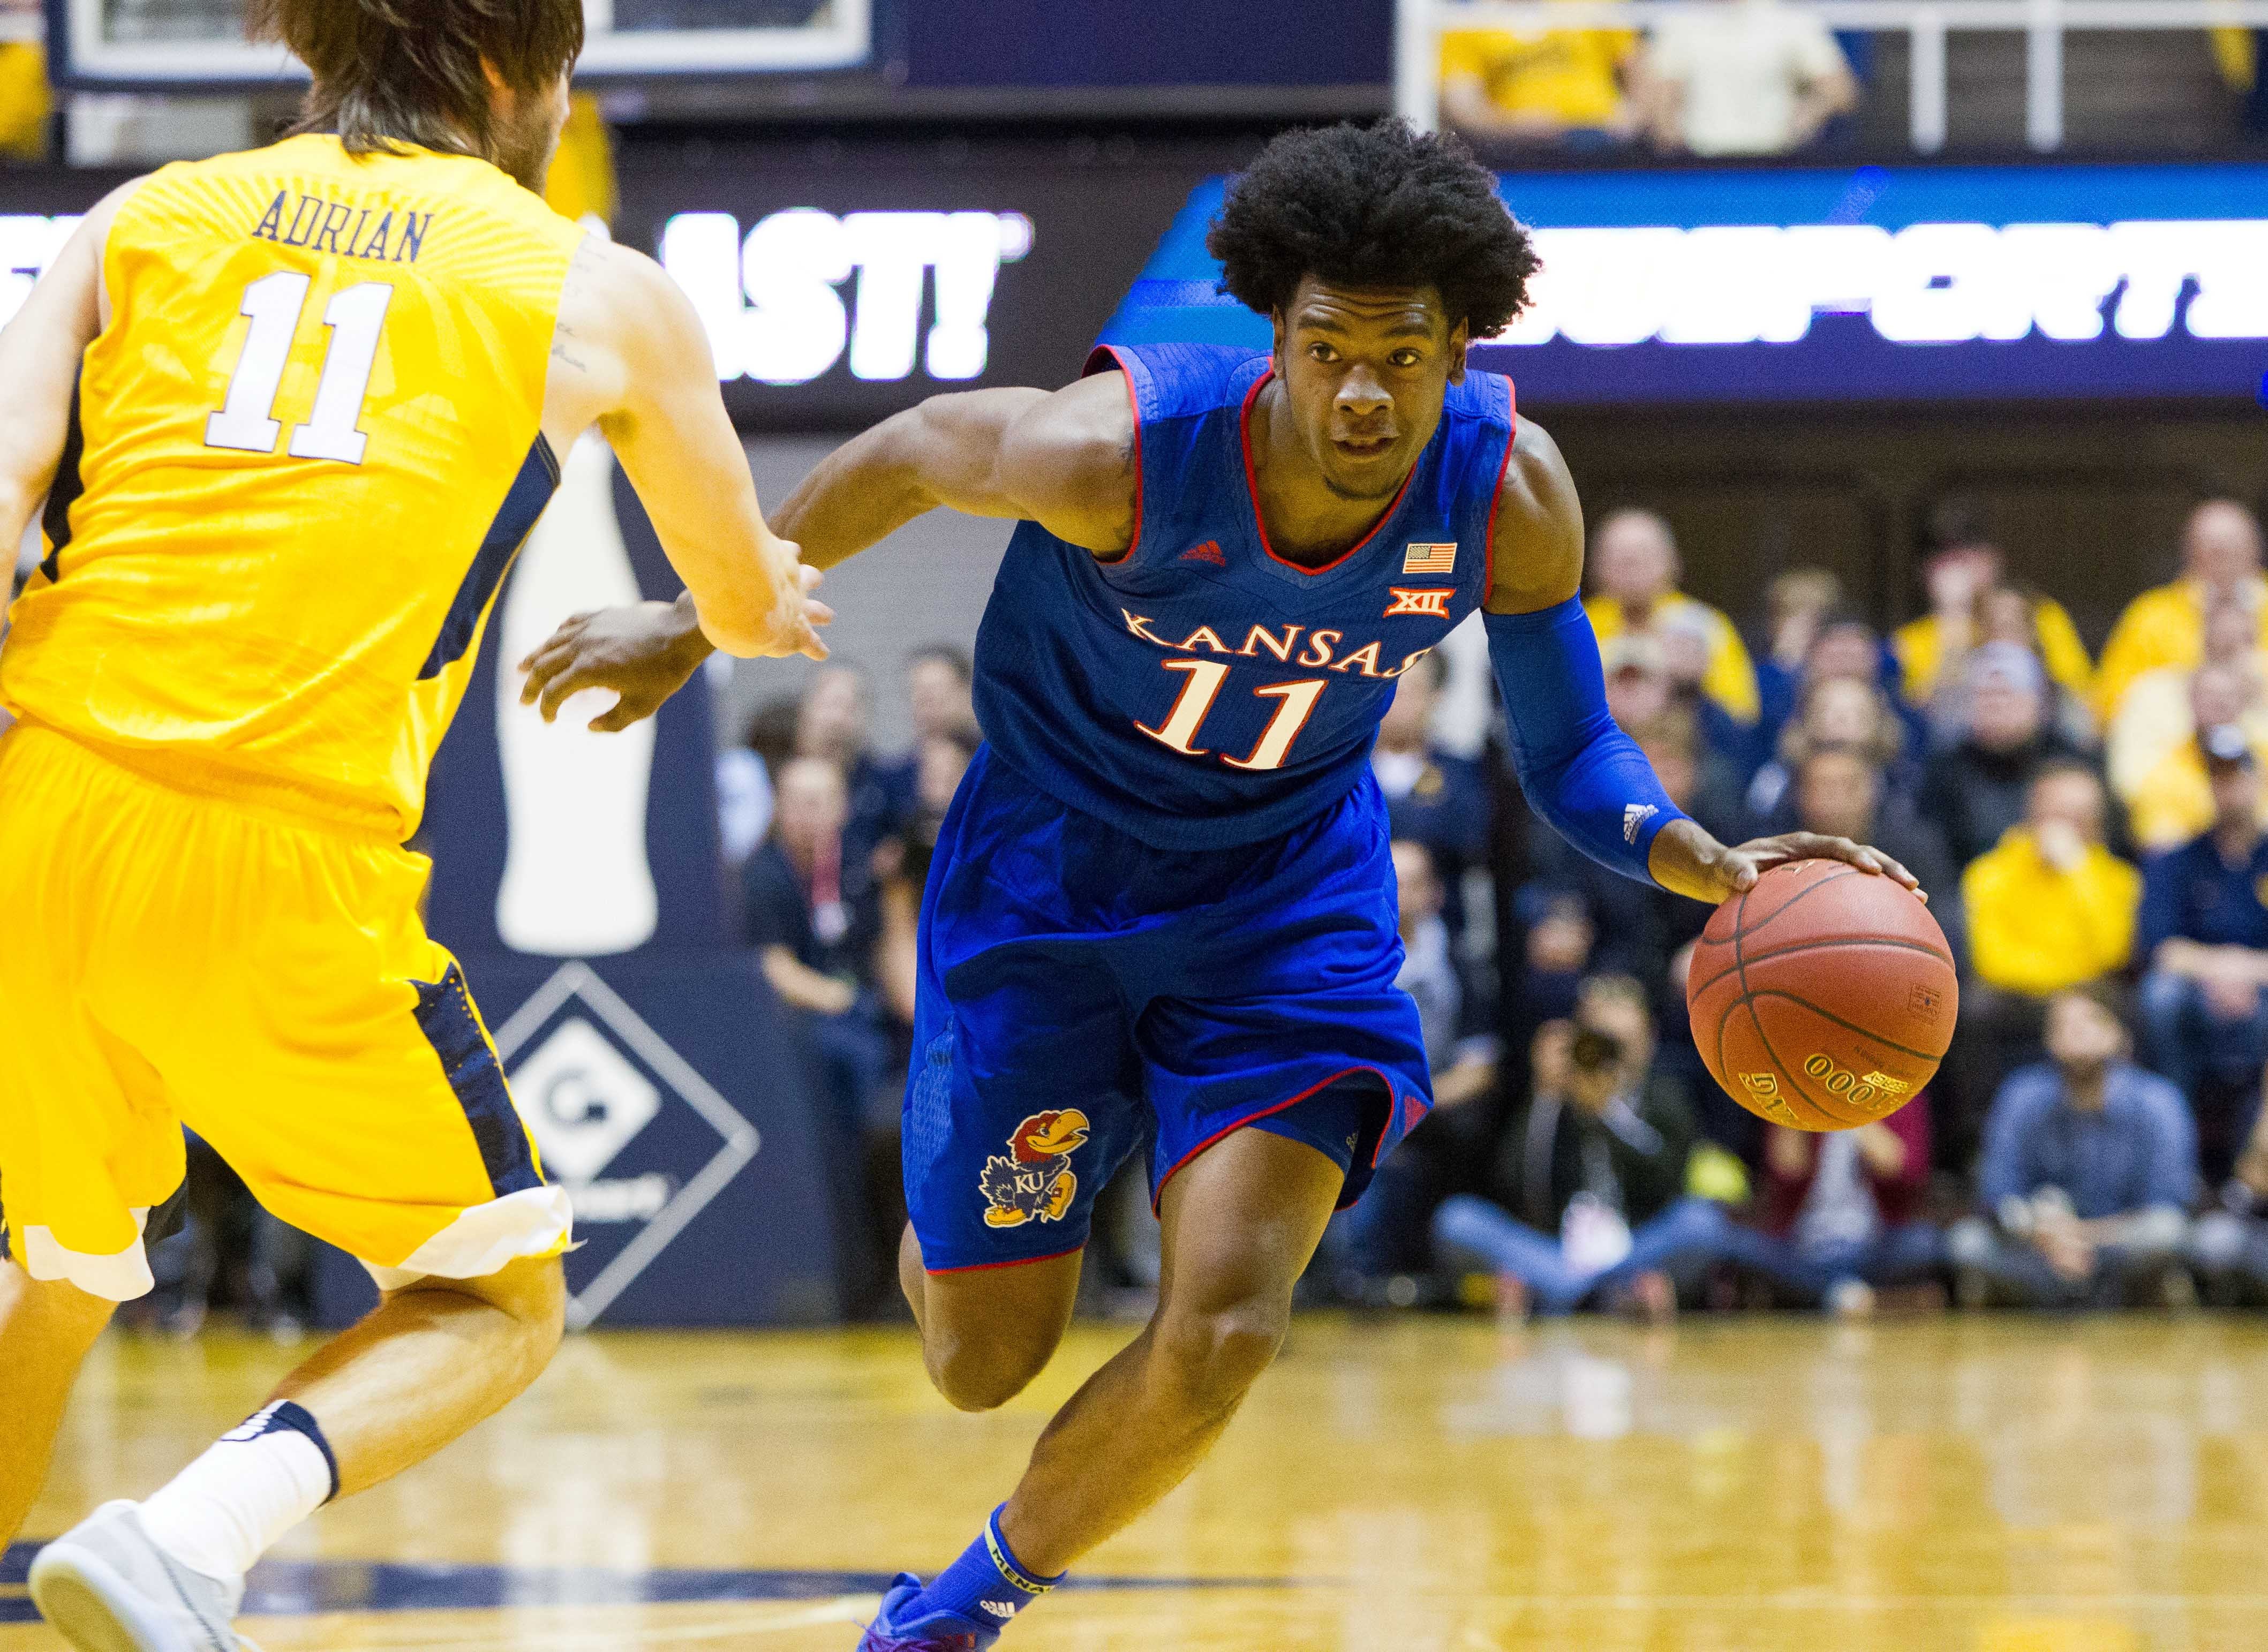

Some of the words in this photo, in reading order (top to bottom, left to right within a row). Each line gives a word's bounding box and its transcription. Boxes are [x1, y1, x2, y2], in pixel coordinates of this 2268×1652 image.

[252, 189, 433, 264] ADRIAN
[204, 270, 394, 465] 11
[1386, 589, 1452, 616] XII
[1121, 608, 1433, 678] KANSAS
[1134, 659, 1328, 770] 11
[1013, 1171, 1044, 1194] KU
[992, 1548, 1051, 1594] MENA
